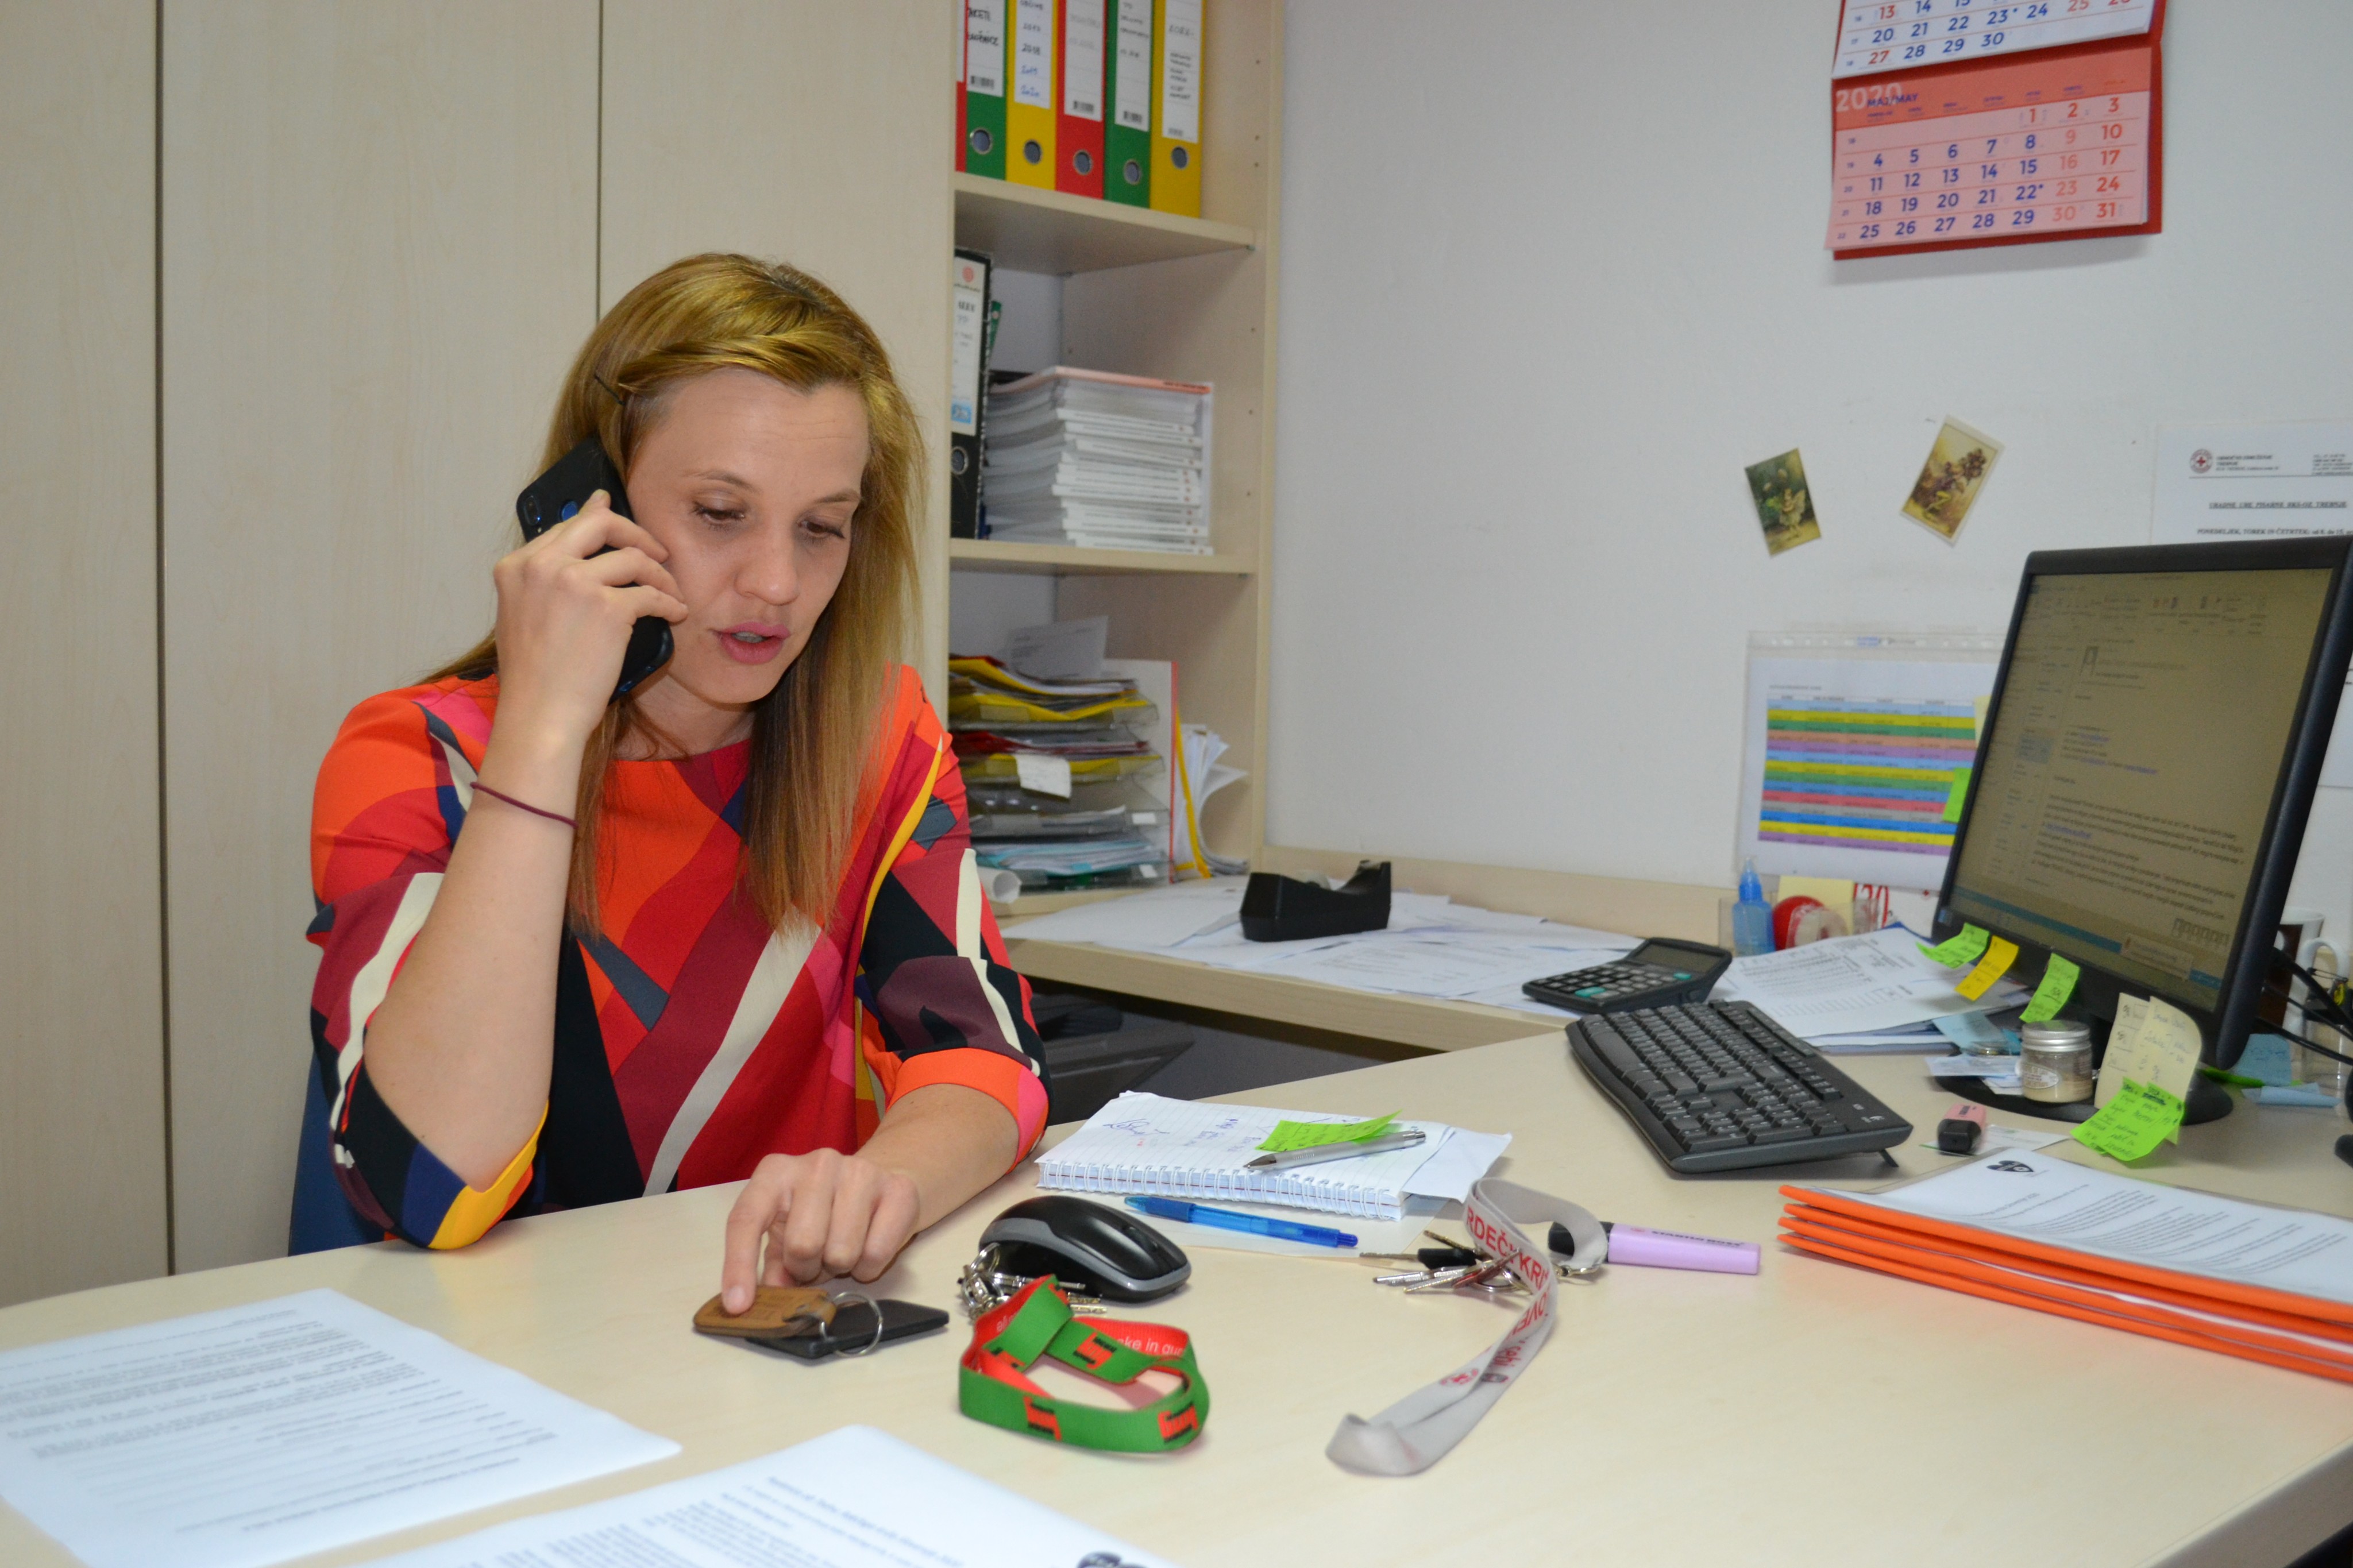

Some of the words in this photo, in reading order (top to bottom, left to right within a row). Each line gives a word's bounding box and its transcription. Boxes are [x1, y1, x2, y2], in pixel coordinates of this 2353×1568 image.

[1873, 29, 1893, 43] 20
[1911, 22, 1928, 37] 21
[1948, 16, 1969, 31] 22
[1987, 9, 2008, 25] 23
[2027, 3, 2047, 18] 24
[2068, 0, 2089, 12] 25
[1880, 5, 1895, 20] 13
[1916, 1, 1931, 14] 14
[1869, 50, 1889, 64] 27
[1904, 45, 1925, 59] 28
[1943, 39, 1965, 53] 29
[1981, 32, 2004, 47] 30
[1836, 83, 1903, 112] 2020
[2030, 108, 2036, 123] 1
[2067, 102, 2078, 118] 2
[2108, 97, 2119, 113] 3
[1874, 153, 1883, 167] 4
[1910, 149, 1919, 163] 5
[1948, 144, 1958, 159] 6
[1986, 139, 1997, 154] 7
[2025, 134, 2035, 149] 8
[2066, 129, 2077, 144] 9
[2101, 123, 2123, 140] 10
[1870, 177, 1883, 191] 11
[1904, 173, 1920, 187] 12
[1942, 168, 1959, 183] 13
[1981, 164, 1997, 179] 14
[2020, 159, 2037, 175] 15
[2060, 154, 2078, 169] 16
[2101, 149, 2120, 165] 17
[1866, 201, 1882, 215] 18
[1901, 197, 1918, 212] 19
[1937, 193, 1959, 208] 20
[1978, 188, 1996, 204] 21
[2015, 184, 2038, 200] 22
[2055, 180, 2077, 196] 23
[2096, 176, 2120, 192] 24
[1860, 224, 1880, 238] 25
[1895, 221, 1916, 235] 26
[1934, 217, 1955, 232] 27
[1972, 213, 1994, 229] 28
[2012, 210, 2034, 225] 29
[2053, 206, 2076, 222] 30
[2096, 202, 2116, 218] 31
